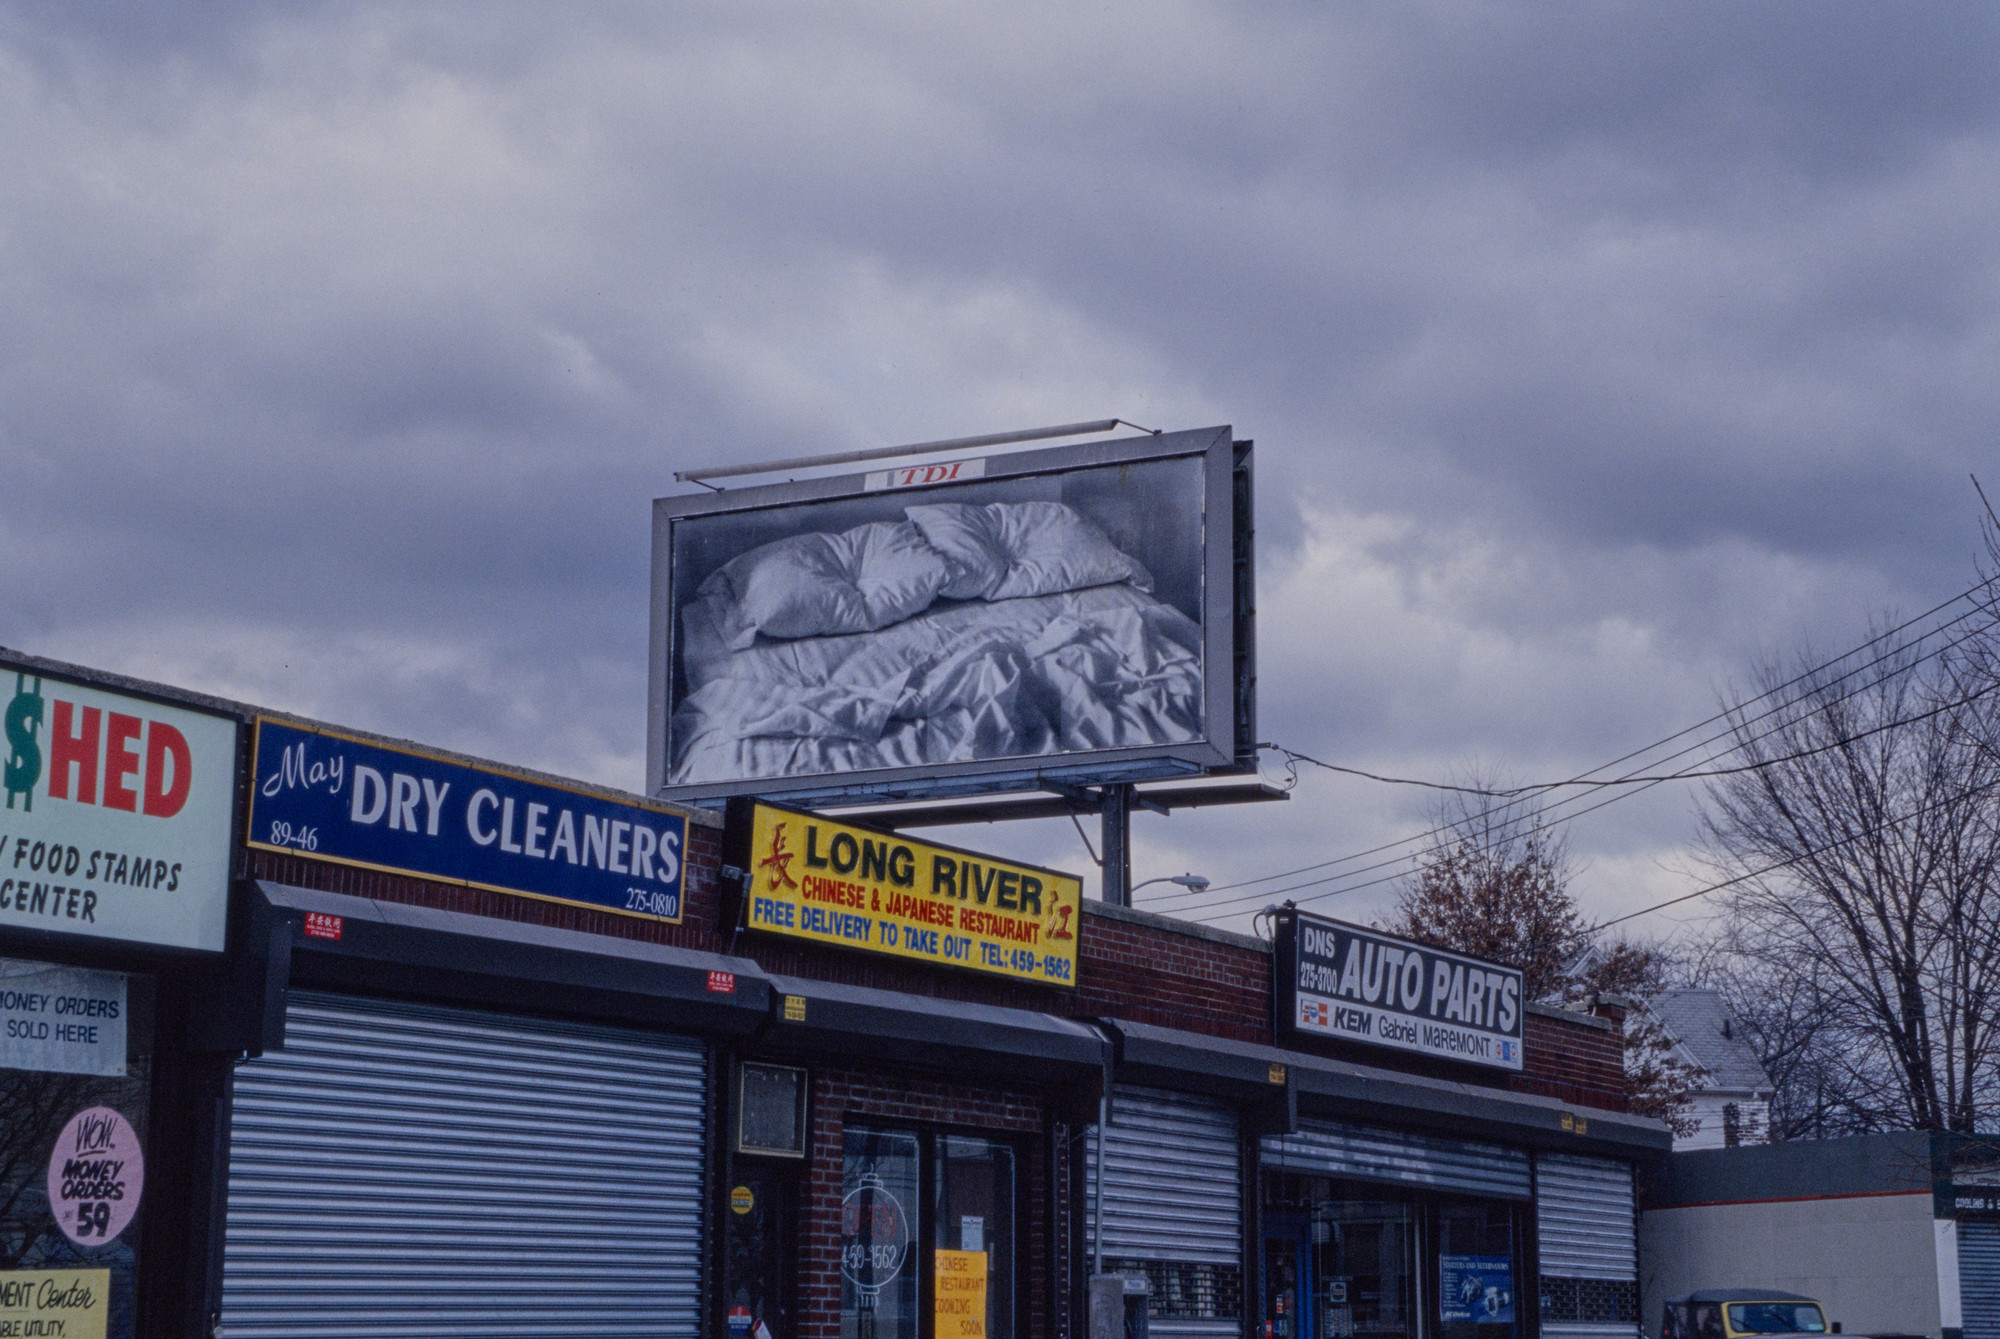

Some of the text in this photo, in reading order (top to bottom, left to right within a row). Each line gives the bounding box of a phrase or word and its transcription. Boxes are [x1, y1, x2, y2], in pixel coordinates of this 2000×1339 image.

[901, 463, 963, 485] TDI
[262, 742, 679, 884] May DRY CLEANERS
[270, 820, 318, 851] 89-46
[13, 838, 182, 891] FOOD STAMPS
[804, 825, 1043, 916] LONG RIVER
[0, 878, 98, 923] CENTER
[625, 887, 677, 917] 275-0810
[801, 874, 1040, 945] CHINESE & JAPANESE RESTAURANT
[753, 896, 795, 928] FREE
[800, 902, 873, 942] DELIVERY
[878, 920, 898, 947] TO
[902, 926, 939, 955] TAKE
[943, 935, 972, 961] OUT
[1304, 926, 1335, 959] DNS
[1300, 961, 1338, 995] 275-3700
[1338, 938, 1518, 1033] AUTO PARTS
[0, 990, 120, 1019] ONEY ORDERS
[7, 1019, 98, 1044] SOLD HERE
[1334, 1006, 1372, 1036] KEM
[1378, 1015, 1418, 1045] Gabriel
[62, 1158, 124, 1181] MONEY
[61, 1179, 126, 1201] ORDERS
[76, 1202, 111, 1237] 59
[841, 1244, 897, 1270] 459-1562
[935, 1255, 968, 1272] CHINESE
[37, 1278, 97, 1310] Center
[940, 1276, 984, 1292] RESTAURANT
[960, 1319, 983, 1336] SOON
